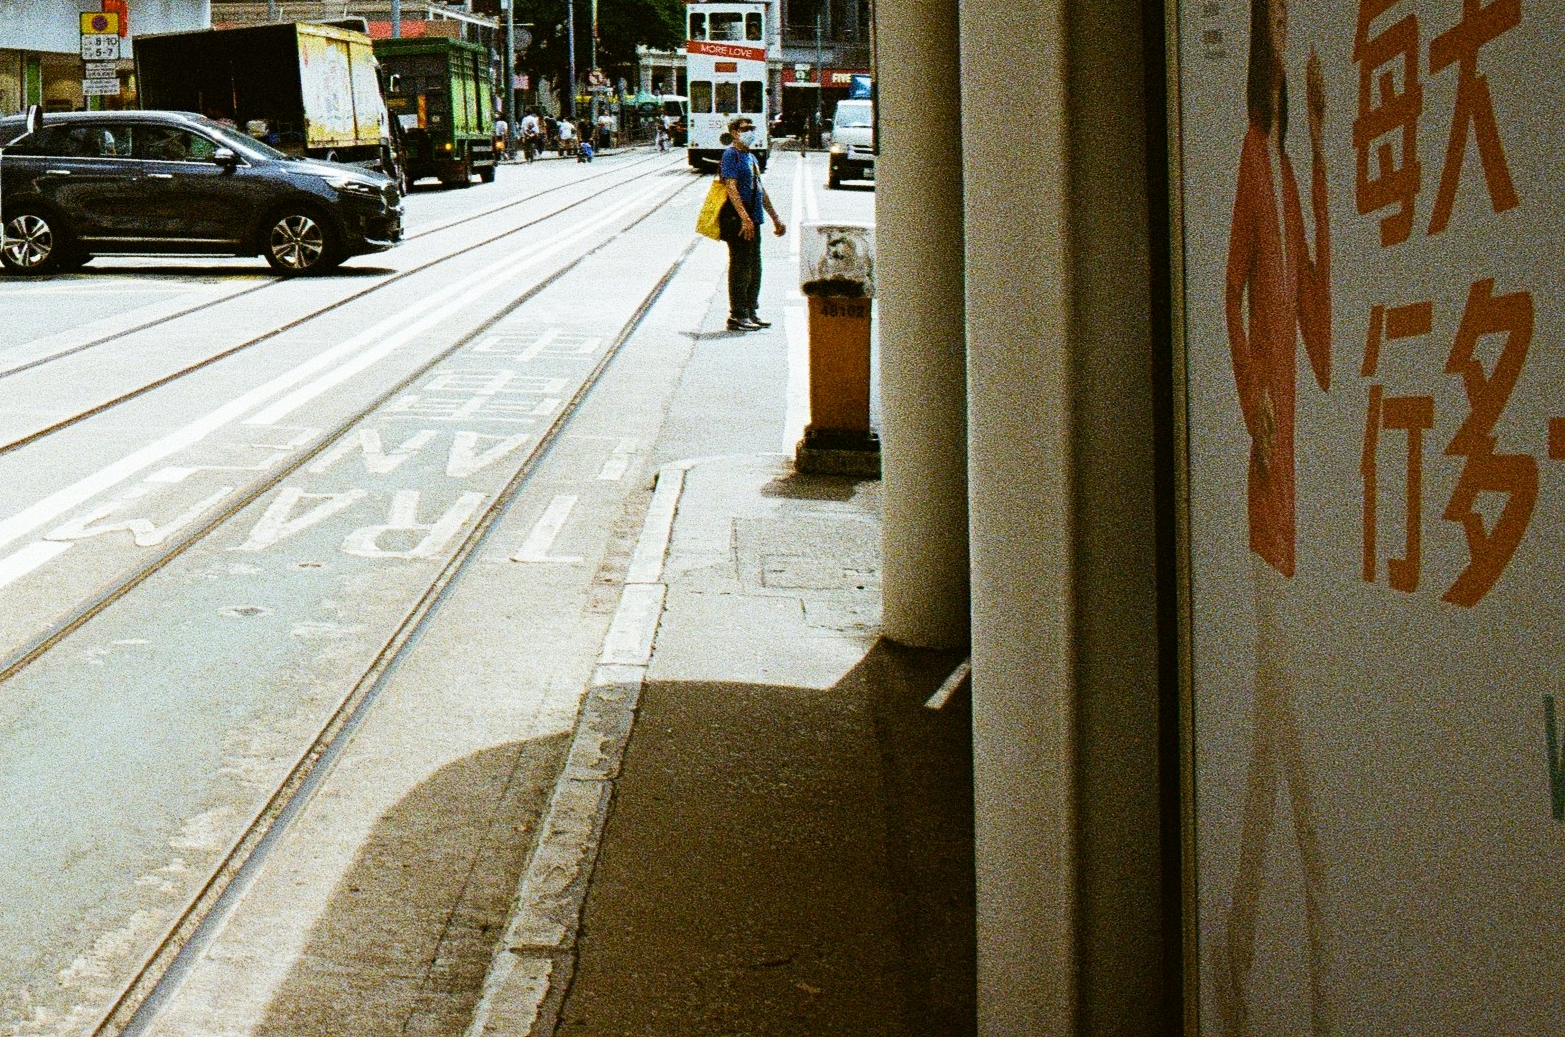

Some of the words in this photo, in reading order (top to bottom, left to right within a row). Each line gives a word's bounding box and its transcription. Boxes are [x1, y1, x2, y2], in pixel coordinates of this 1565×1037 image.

[700, 44, 728, 56] MORE
[728, 47, 753, 58] LOVE
[831, 72, 852, 84] FIVE
[144, 424, 638, 482] LANE
[42, 487, 583, 564] TRAM
